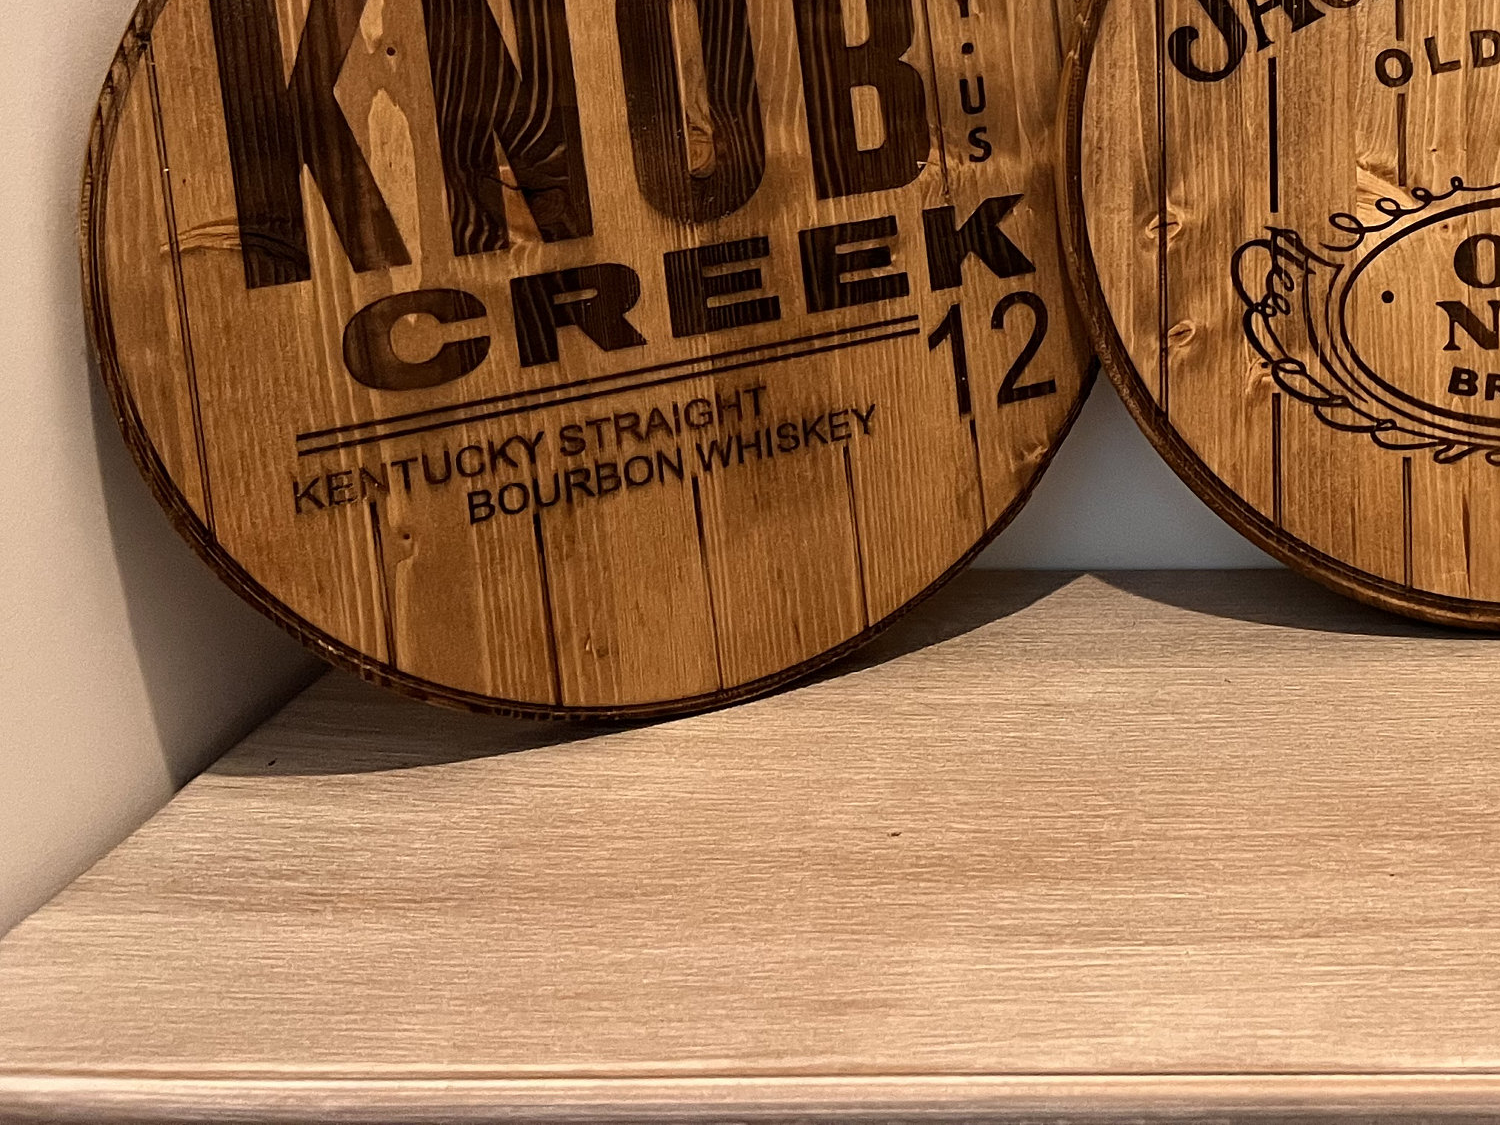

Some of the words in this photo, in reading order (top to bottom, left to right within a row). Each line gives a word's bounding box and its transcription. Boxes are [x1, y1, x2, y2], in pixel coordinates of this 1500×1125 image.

[342, 193, 1038, 392] CREEK
[927, 291, 1056, 418] 12
[293, 431, 545, 515] KENTUCKY
[558, 385, 768, 460] STRAIGHT
[466, 446, 682, 525] BOURBON
[696, 402, 877, 472] WHISKEY
